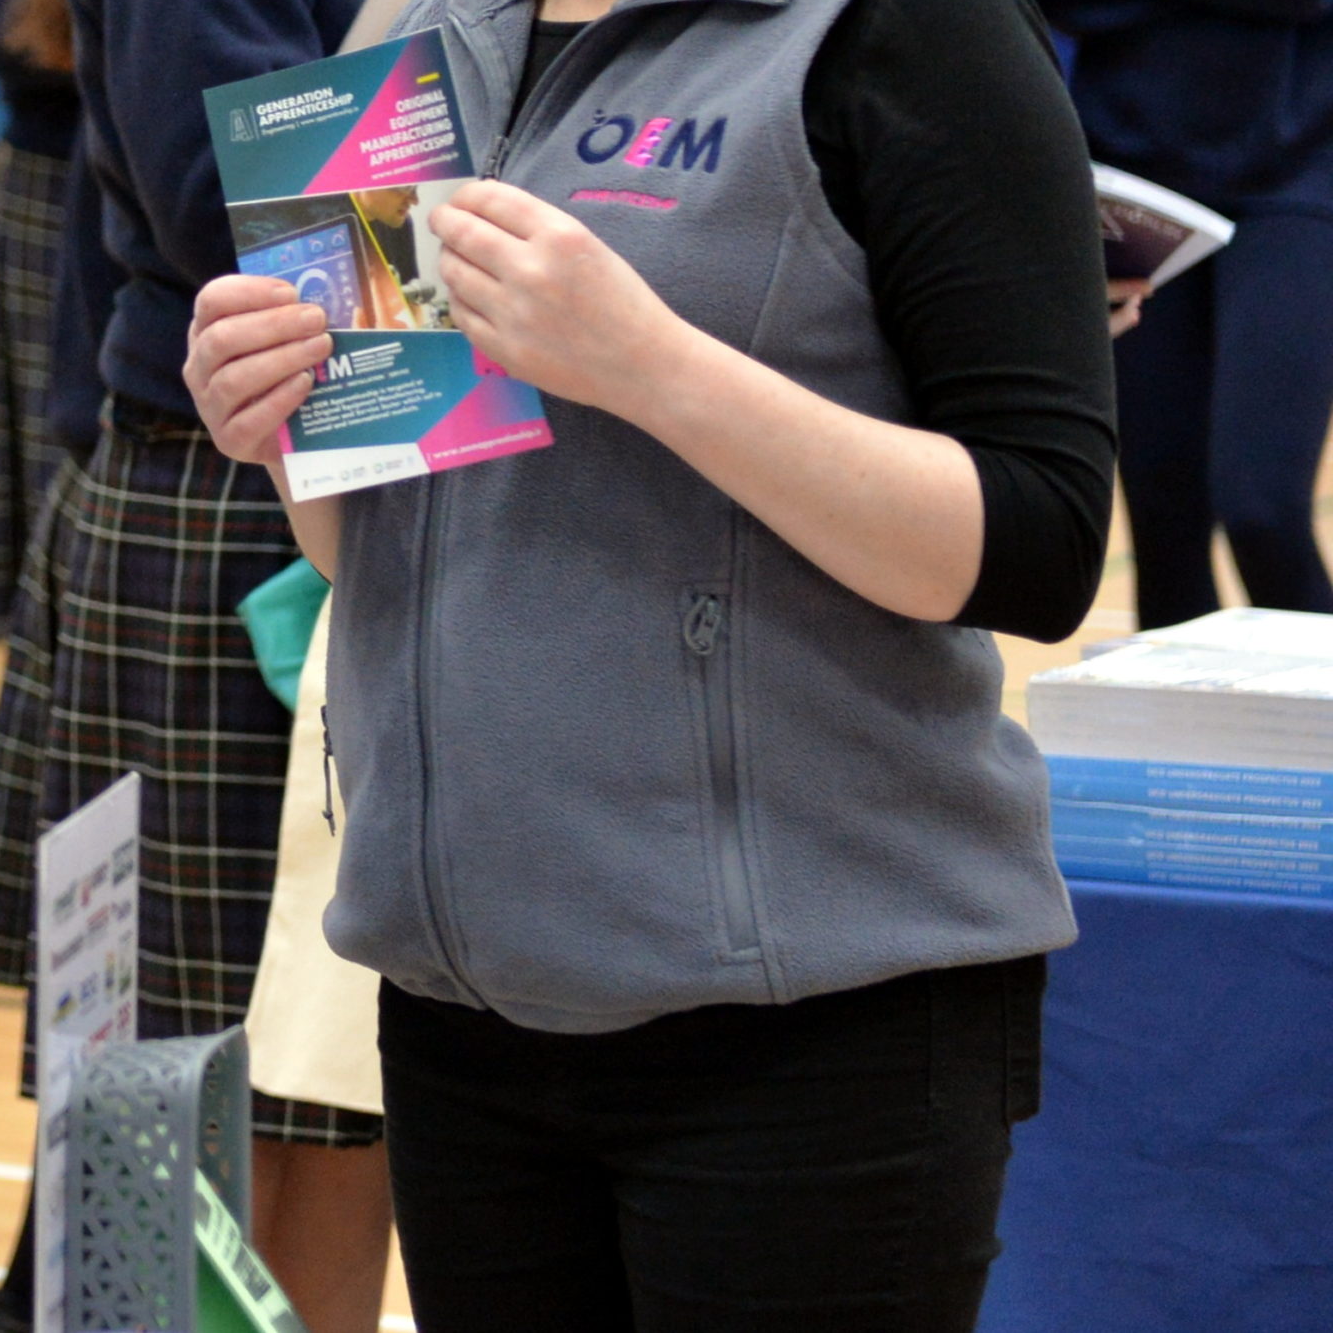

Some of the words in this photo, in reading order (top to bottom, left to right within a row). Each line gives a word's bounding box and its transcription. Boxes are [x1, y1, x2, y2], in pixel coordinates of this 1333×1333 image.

[256, 86, 333, 115] GENERATION
[259, 93, 354, 126] APPRENTICESHIP
[389, 102, 449, 130] EQUIPMENT
[395, 88, 446, 113] ORIGINAL
[359, 117, 452, 154] MANUFACTURING
[370, 132, 455, 167] APPRENTICESHIP
